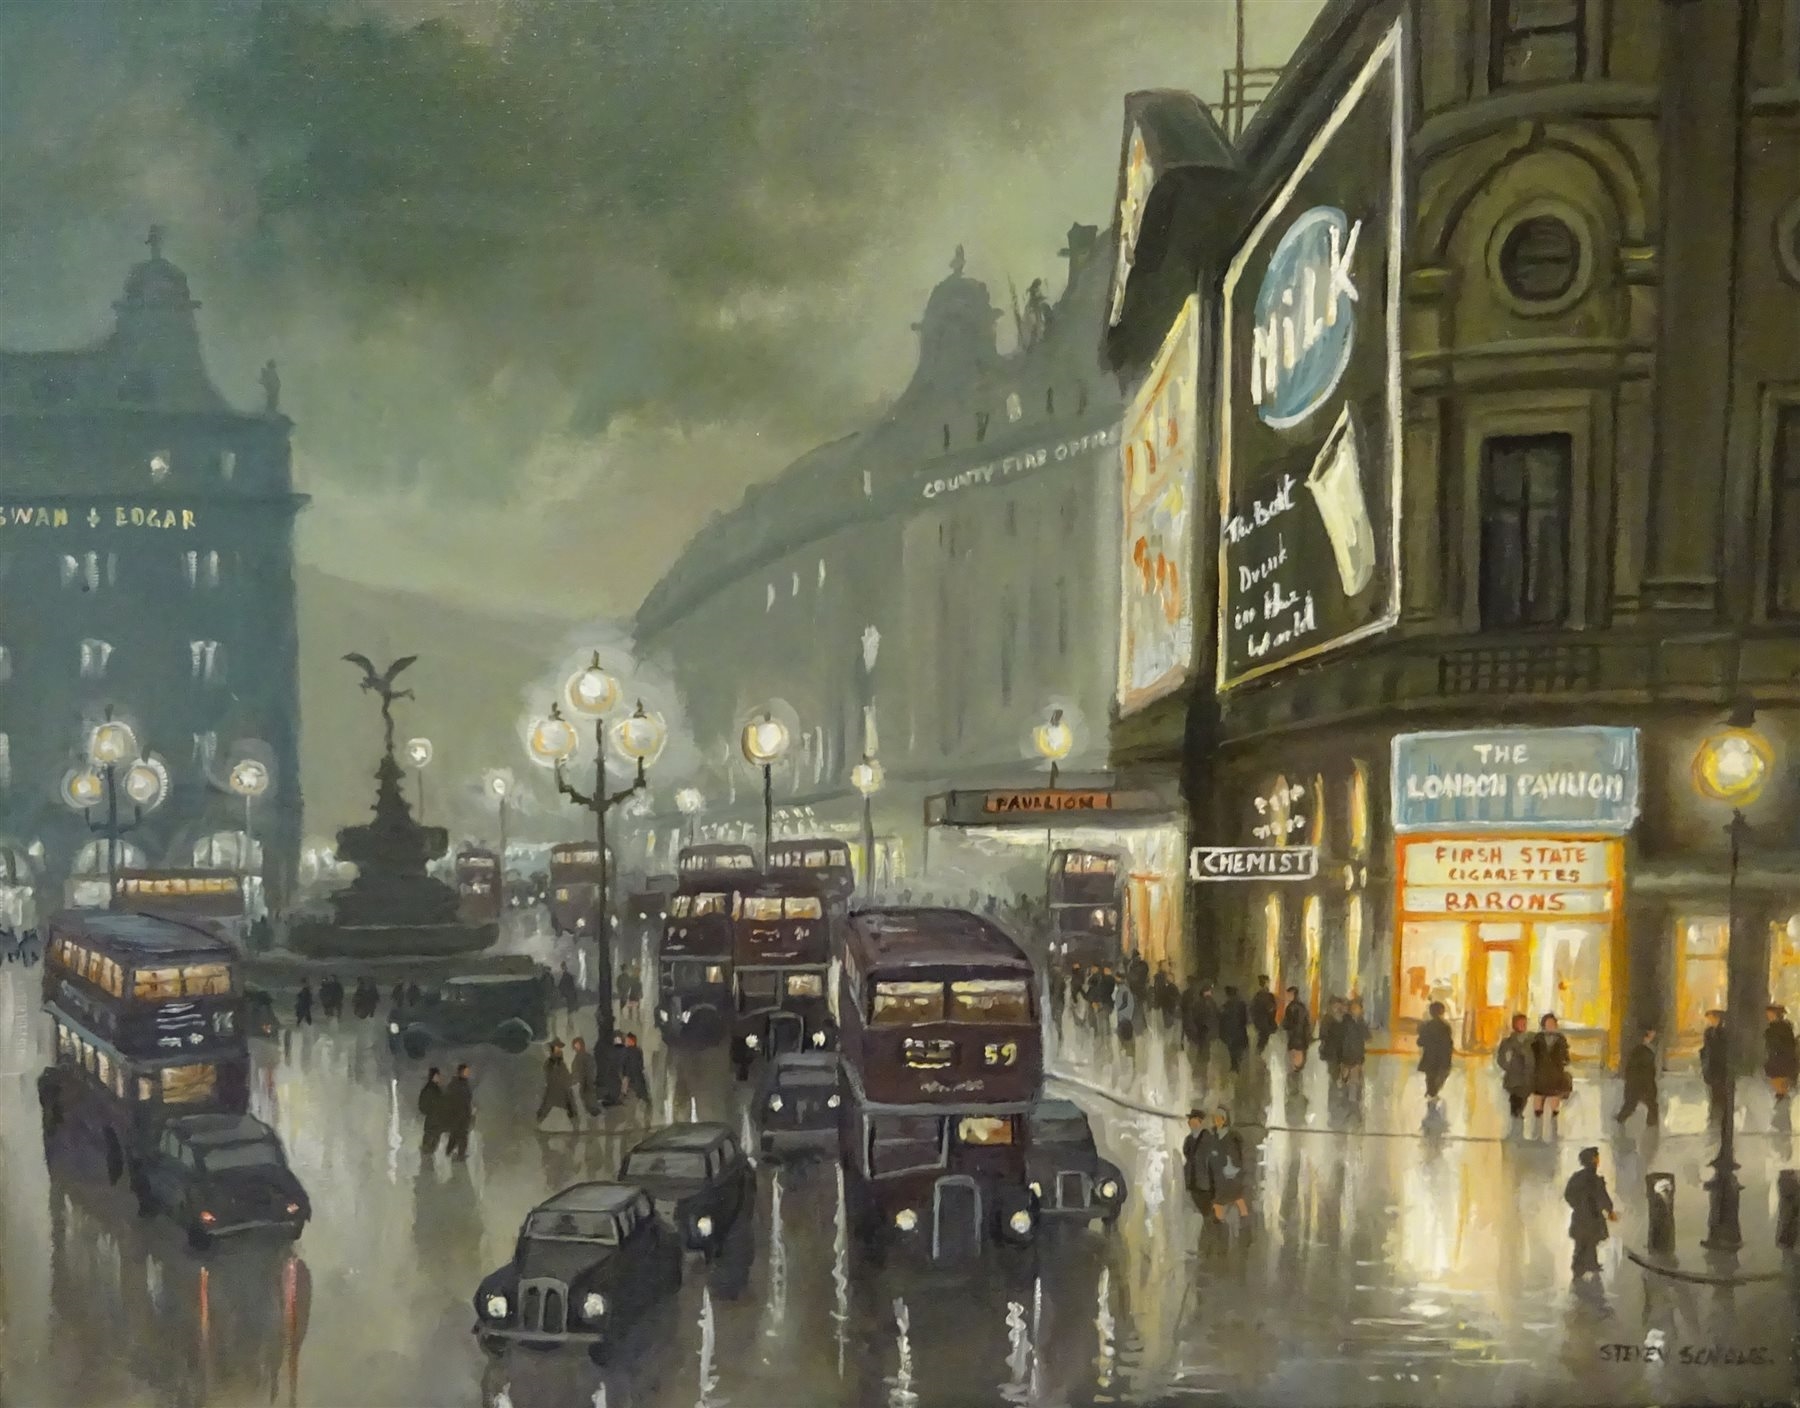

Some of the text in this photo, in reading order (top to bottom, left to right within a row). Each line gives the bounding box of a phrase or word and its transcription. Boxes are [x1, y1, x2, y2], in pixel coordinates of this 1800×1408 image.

[923, 464, 993, 498] COUNTY
[116, 506, 196, 530] EDGAR
[1235, 605, 1256, 630] in
[1473, 744, 1530, 764] THE
[1407, 771, 1624, 801] LONDON PAVILION
[1203, 851, 1309, 874] CHEMIST
[1520, 846, 1589, 864] STATE
[1448, 868, 1581, 883] CIGARETTES
[1445, 890, 1568, 912] BARONS
[984, 1043, 1018, 1066] 59
